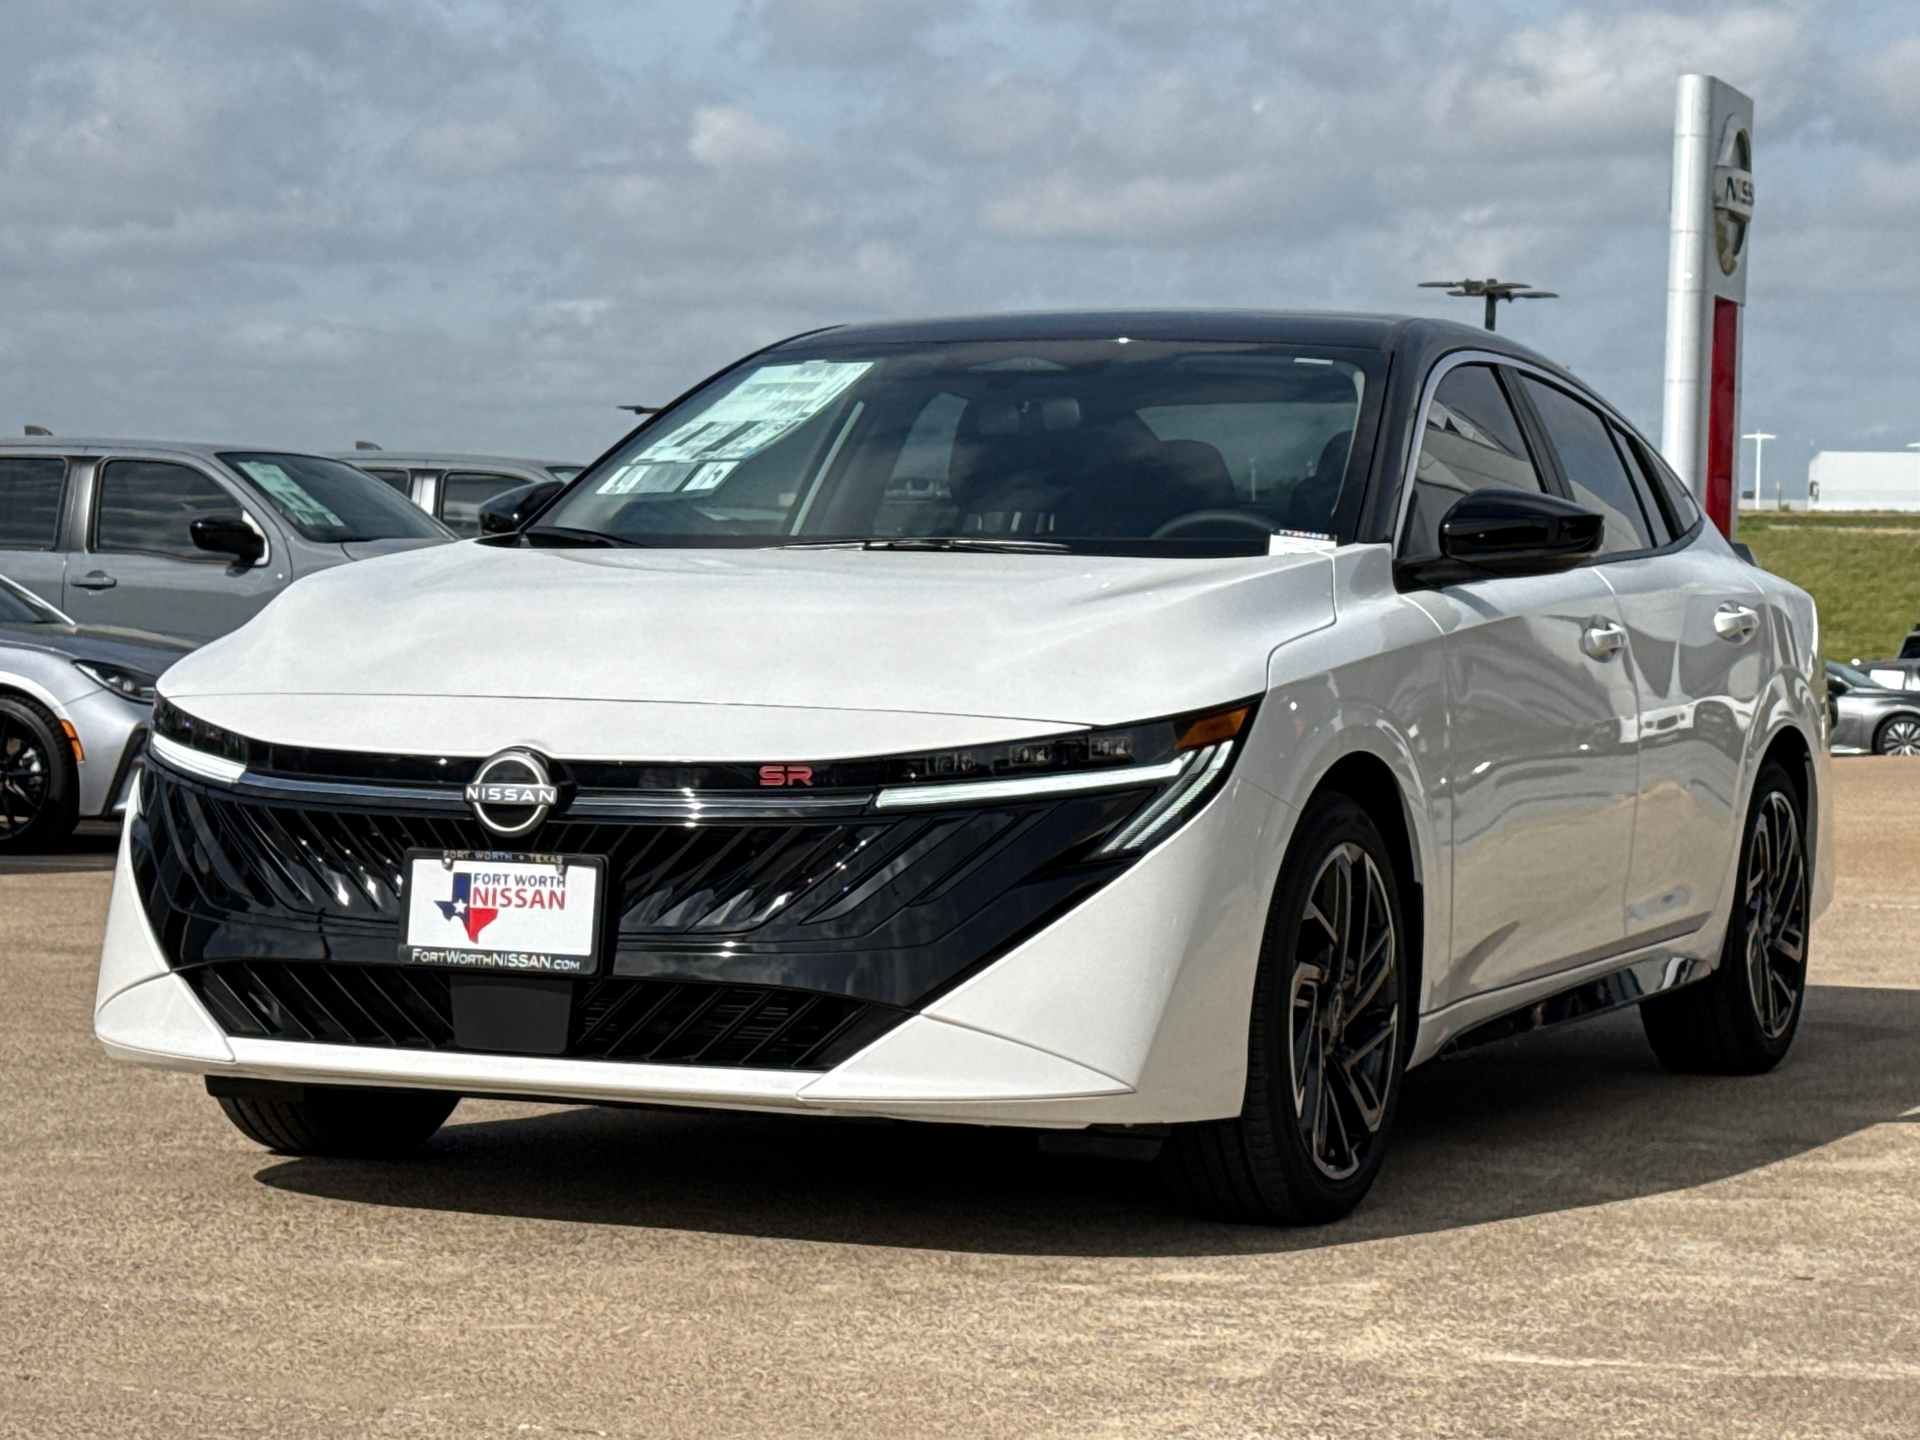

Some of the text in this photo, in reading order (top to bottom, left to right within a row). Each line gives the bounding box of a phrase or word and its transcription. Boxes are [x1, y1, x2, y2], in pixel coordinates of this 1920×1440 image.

[759, 765, 813, 786] SR
[465, 786, 555, 803] NISSAN
[442, 850, 563, 865] FORT WORTH TEXAS
[473, 873, 566, 888] FORT WORTH
[472, 887, 566, 910] NISSAN
